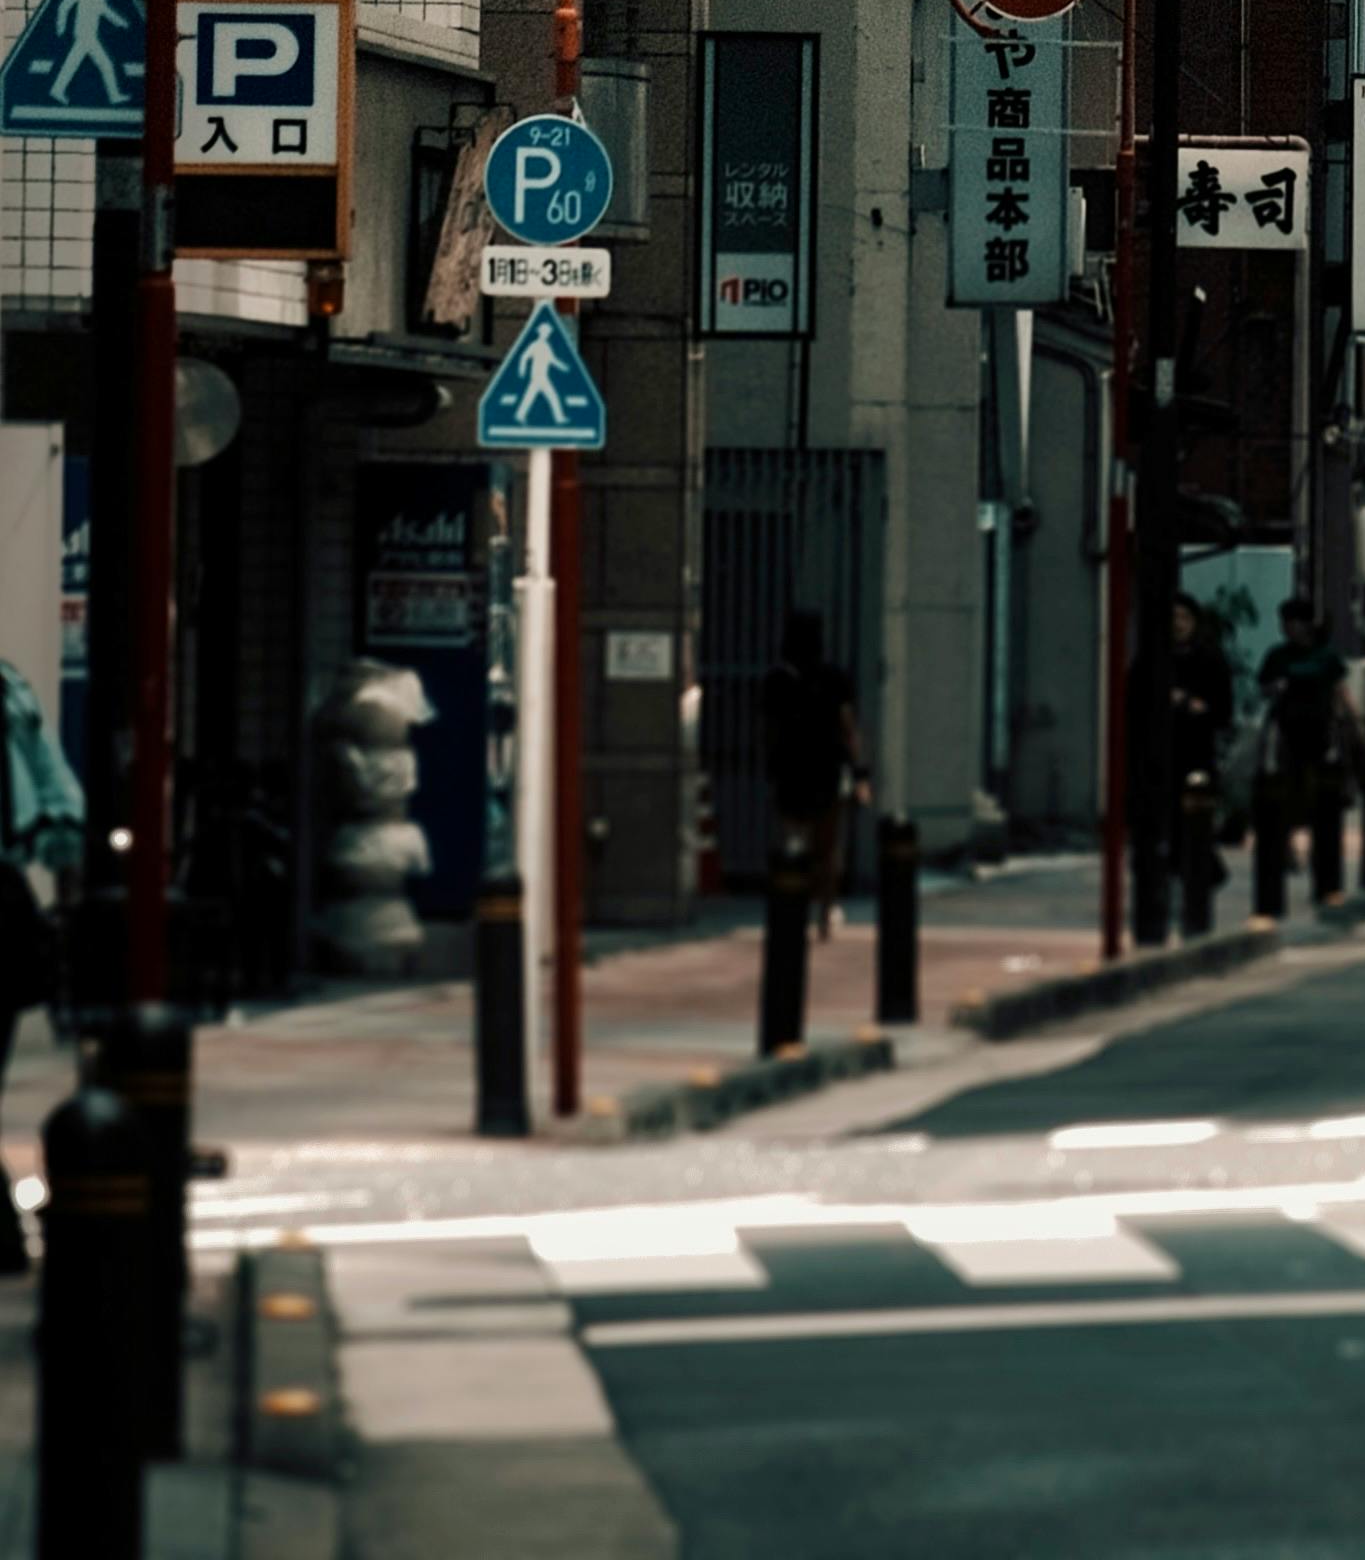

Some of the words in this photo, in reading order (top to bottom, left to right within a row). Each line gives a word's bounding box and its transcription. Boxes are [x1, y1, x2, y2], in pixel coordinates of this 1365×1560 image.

[211, 22, 300, 97] P
[200, 117, 308, 155] 入口
[529, 126, 570, 147] 9-21
[513, 146, 561, 225] P
[723, 161, 790, 179] レンタル
[546, 189, 582, 225] 60
[724, 181, 788, 210] 収納
[723, 210, 790, 227] スペース
